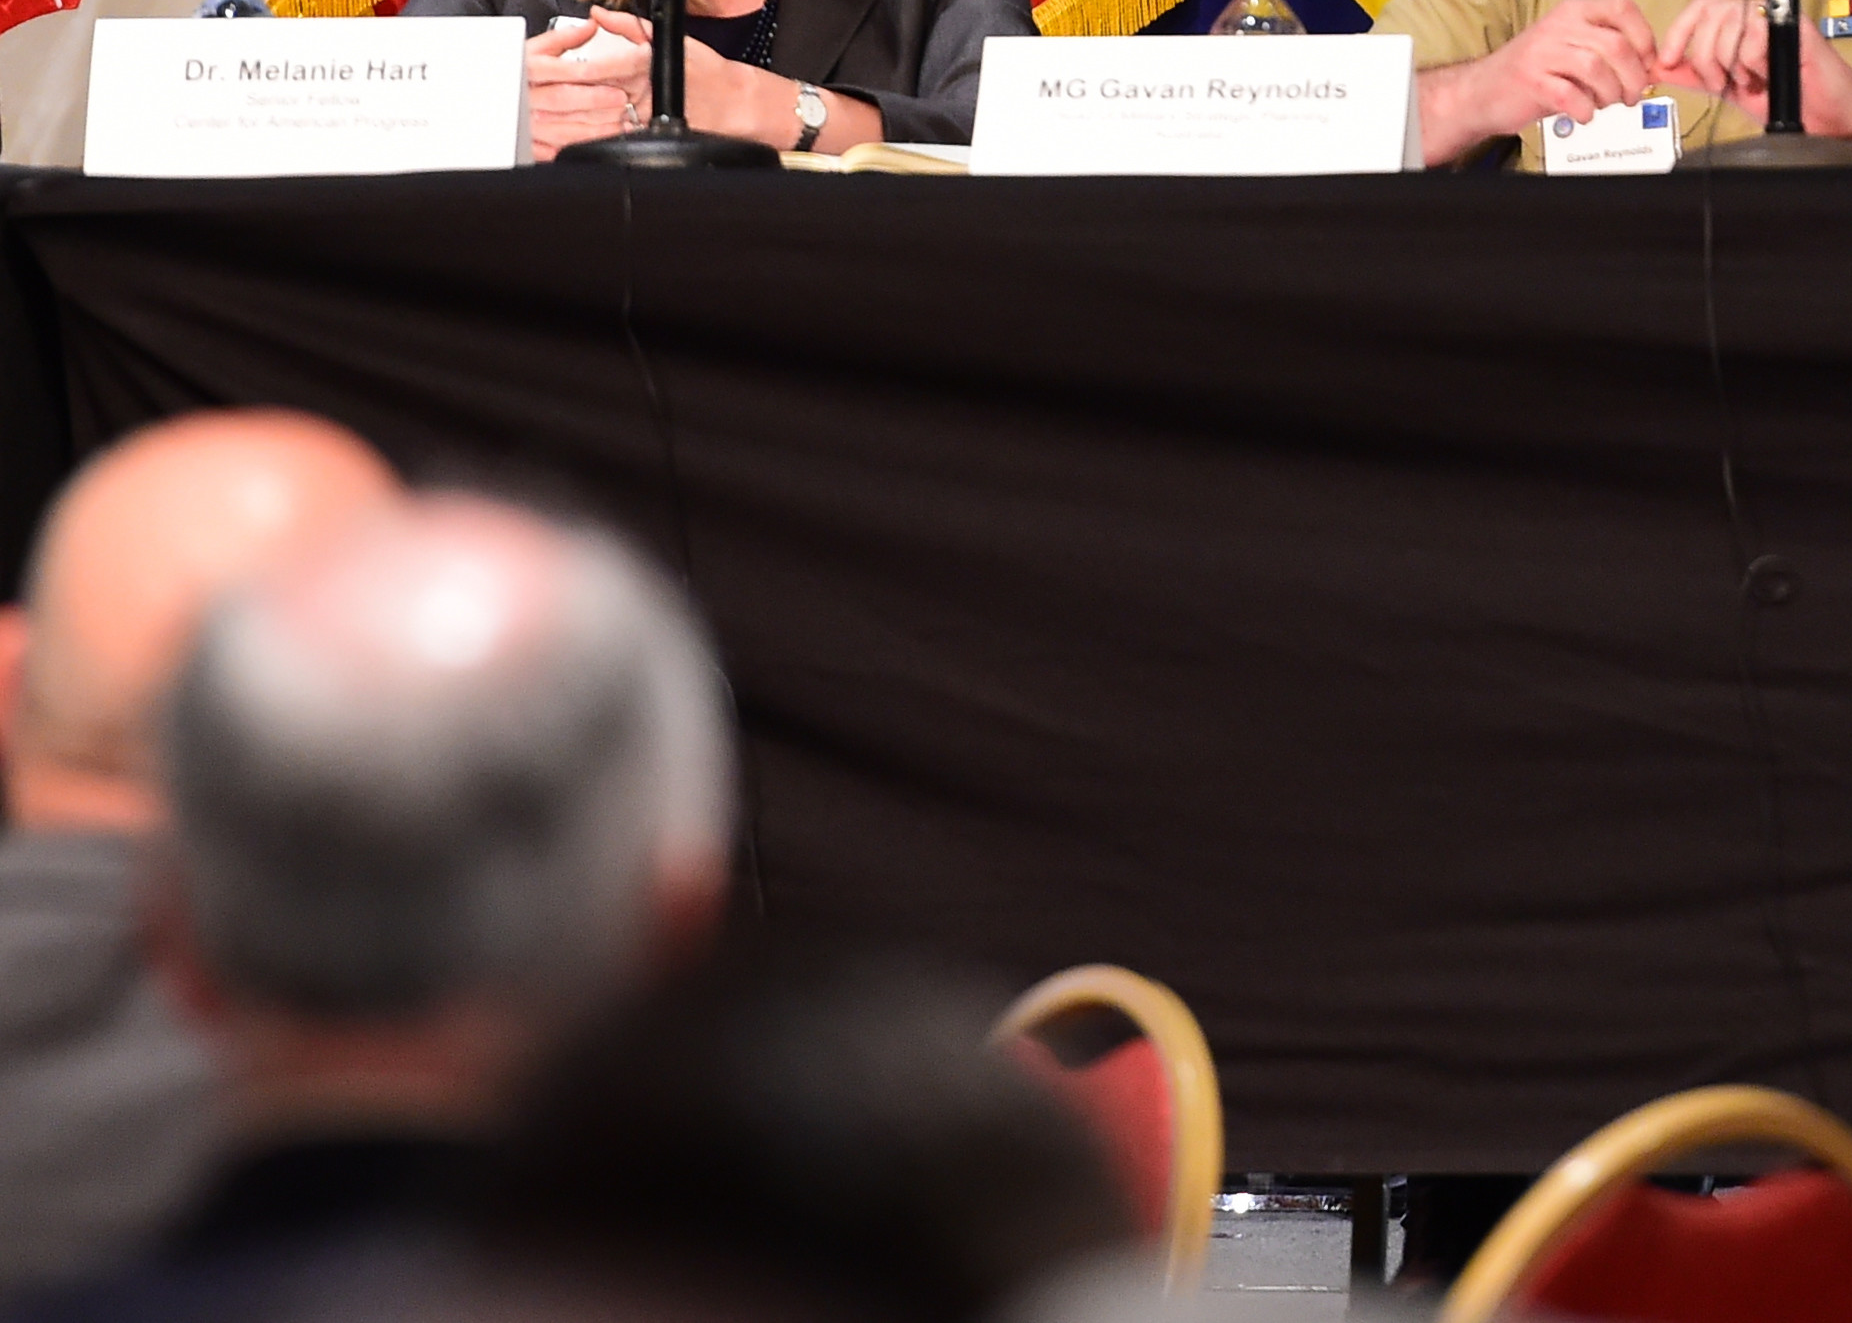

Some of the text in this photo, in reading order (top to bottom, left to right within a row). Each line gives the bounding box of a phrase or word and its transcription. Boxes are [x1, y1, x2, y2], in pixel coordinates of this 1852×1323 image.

[184, 58, 429, 82] Dr. Melanie Hart
[1038, 77, 1349, 106] MG Gavan Reynolds
[1566, 144, 1654, 164] Gavan Reynolds
